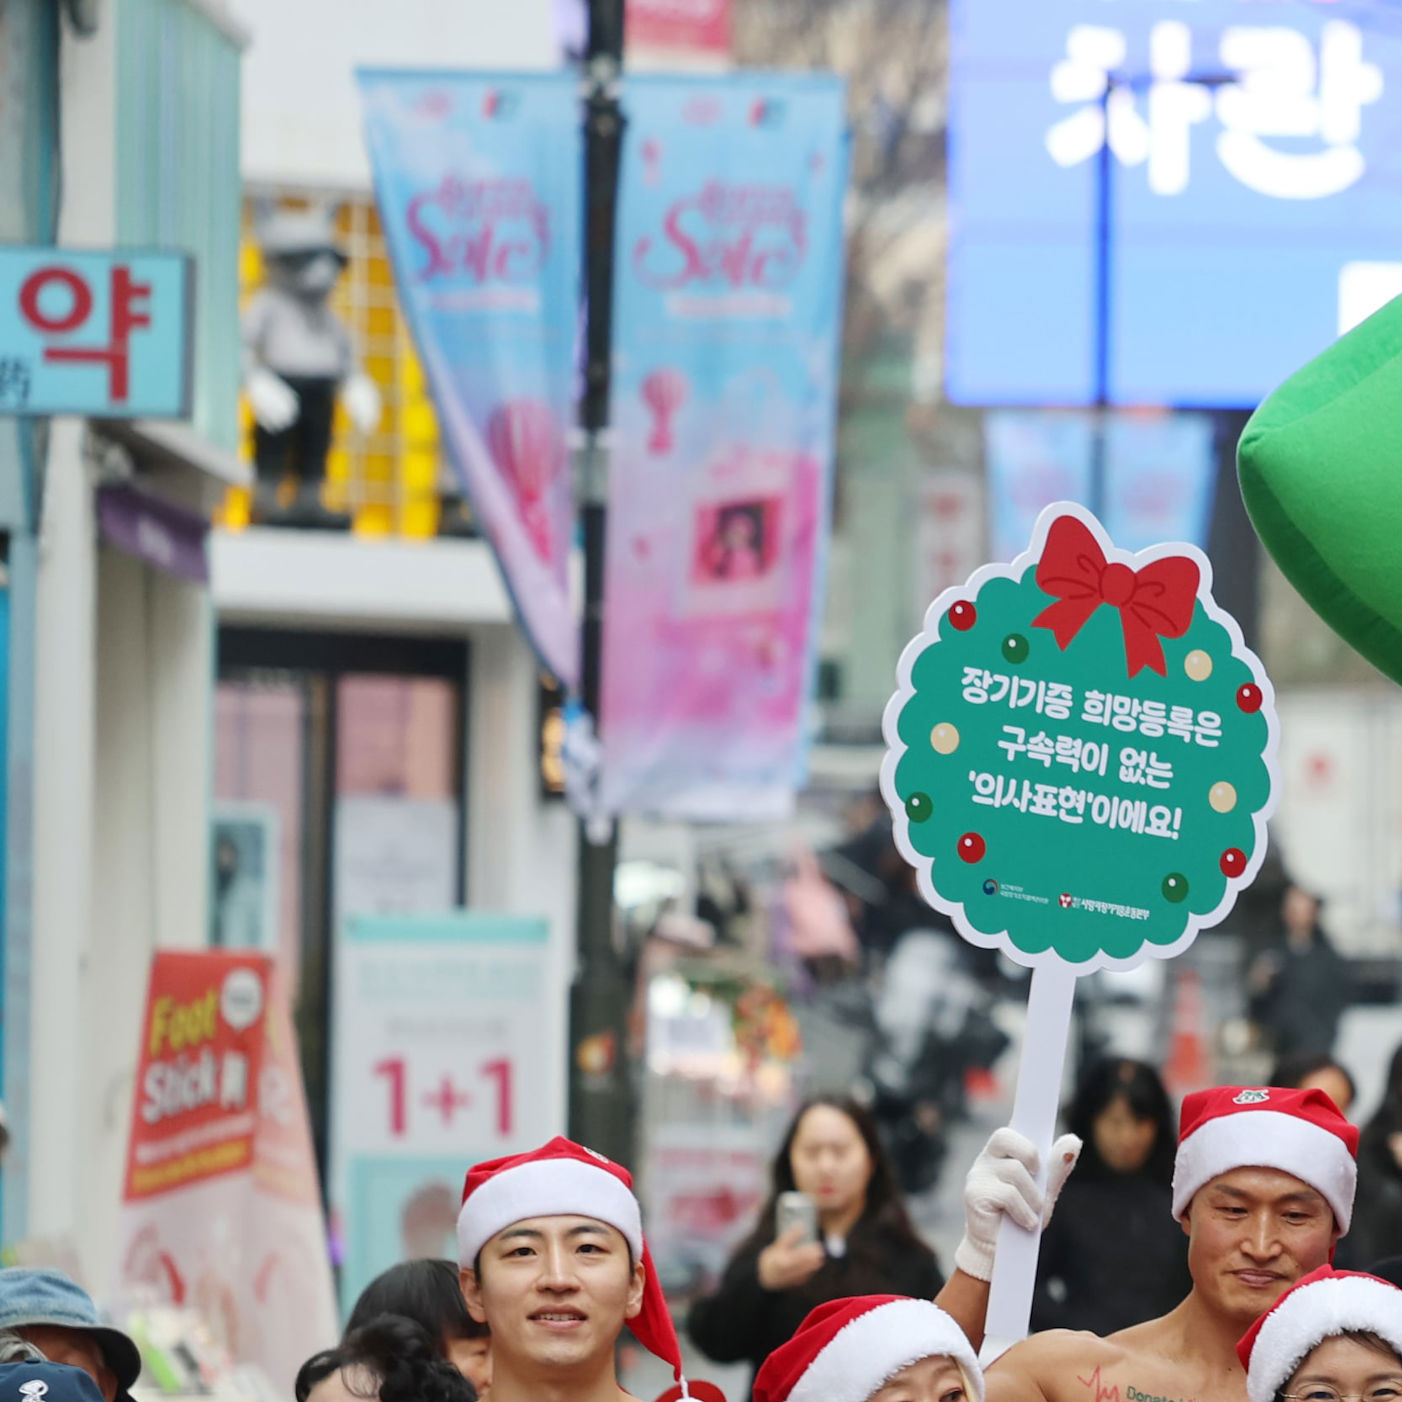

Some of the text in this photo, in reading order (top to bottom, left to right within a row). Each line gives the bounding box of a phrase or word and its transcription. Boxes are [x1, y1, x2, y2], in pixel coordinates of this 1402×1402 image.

[18, 264, 151, 405] 약
[961, 665, 1223, 748] 장기기증 희망등록은
[997, 724, 1174, 790] 구속력이 없는
[968, 769, 1183, 841] '의사표현'이에요!
[370, 1053, 515, 1138] 1+1
